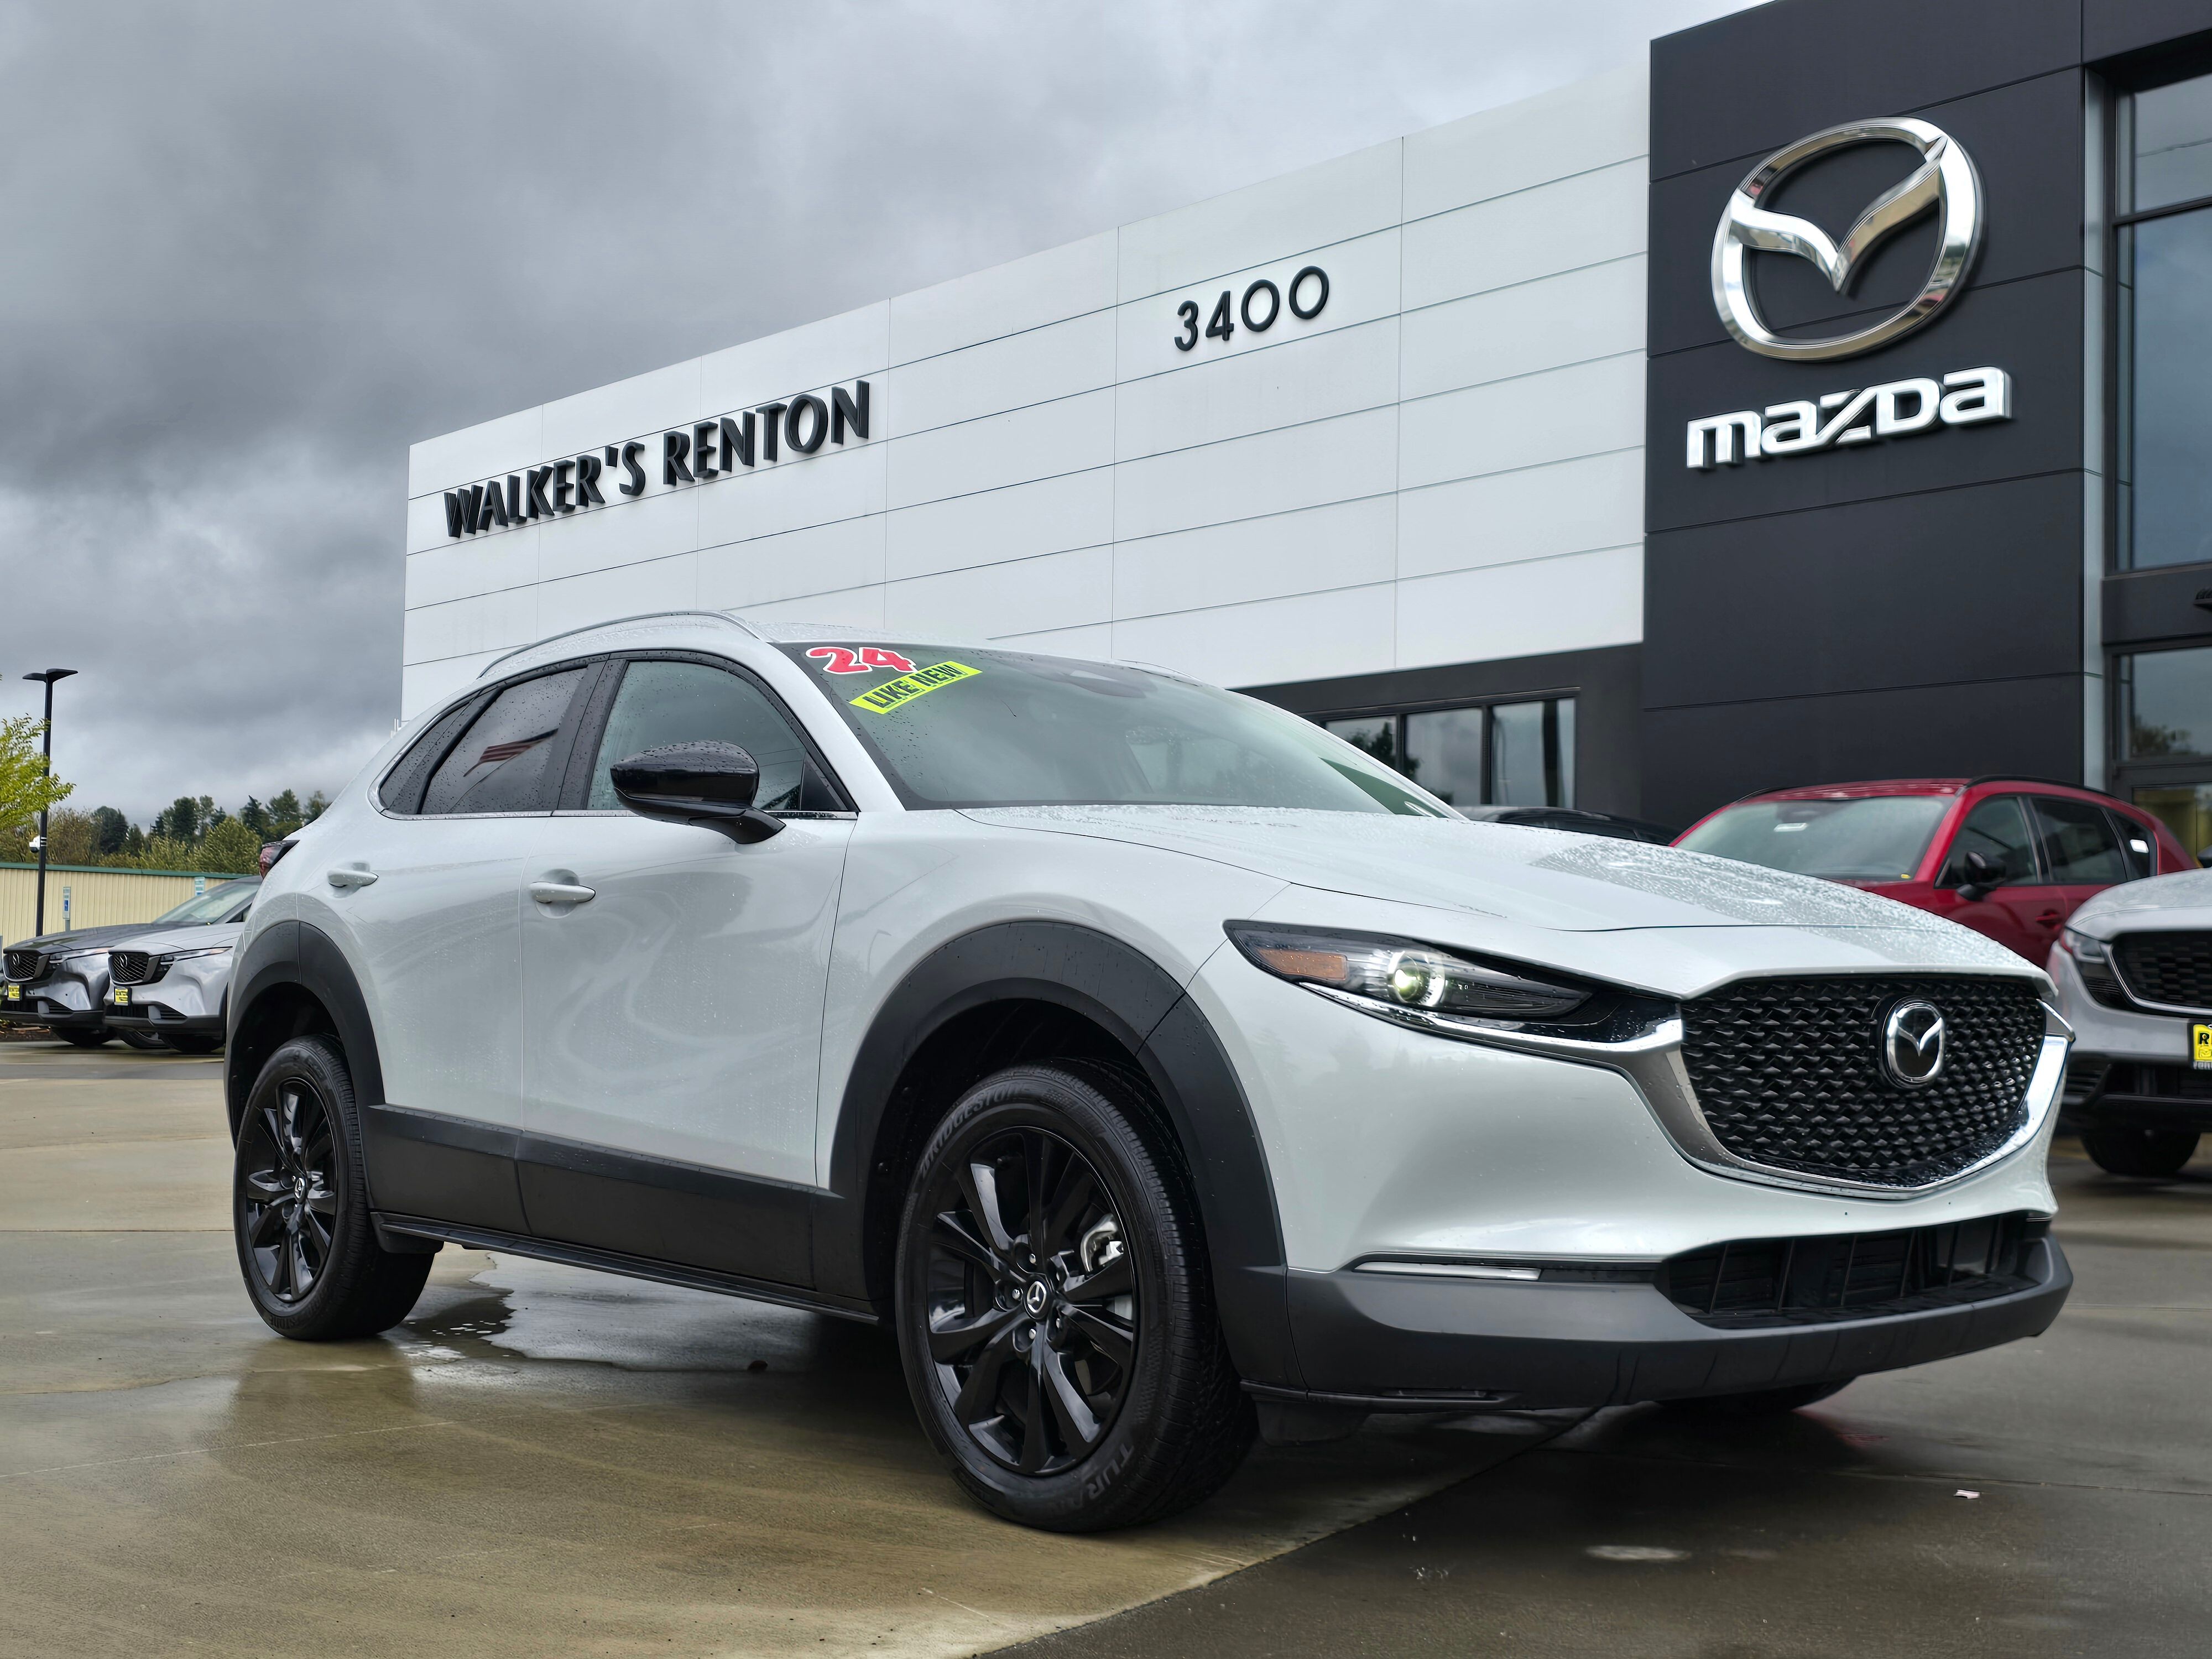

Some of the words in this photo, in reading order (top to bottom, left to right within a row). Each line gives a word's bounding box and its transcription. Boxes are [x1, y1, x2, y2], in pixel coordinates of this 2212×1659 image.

[1174, 265, 1329, 351] 3400
[444, 441, 646, 539] WALKER'S
[663, 380, 870, 486] RENTON
[805, 646, 919, 675] 24
[862, 680, 922, 709] LIKE
[910, 662, 967, 687] NEW
